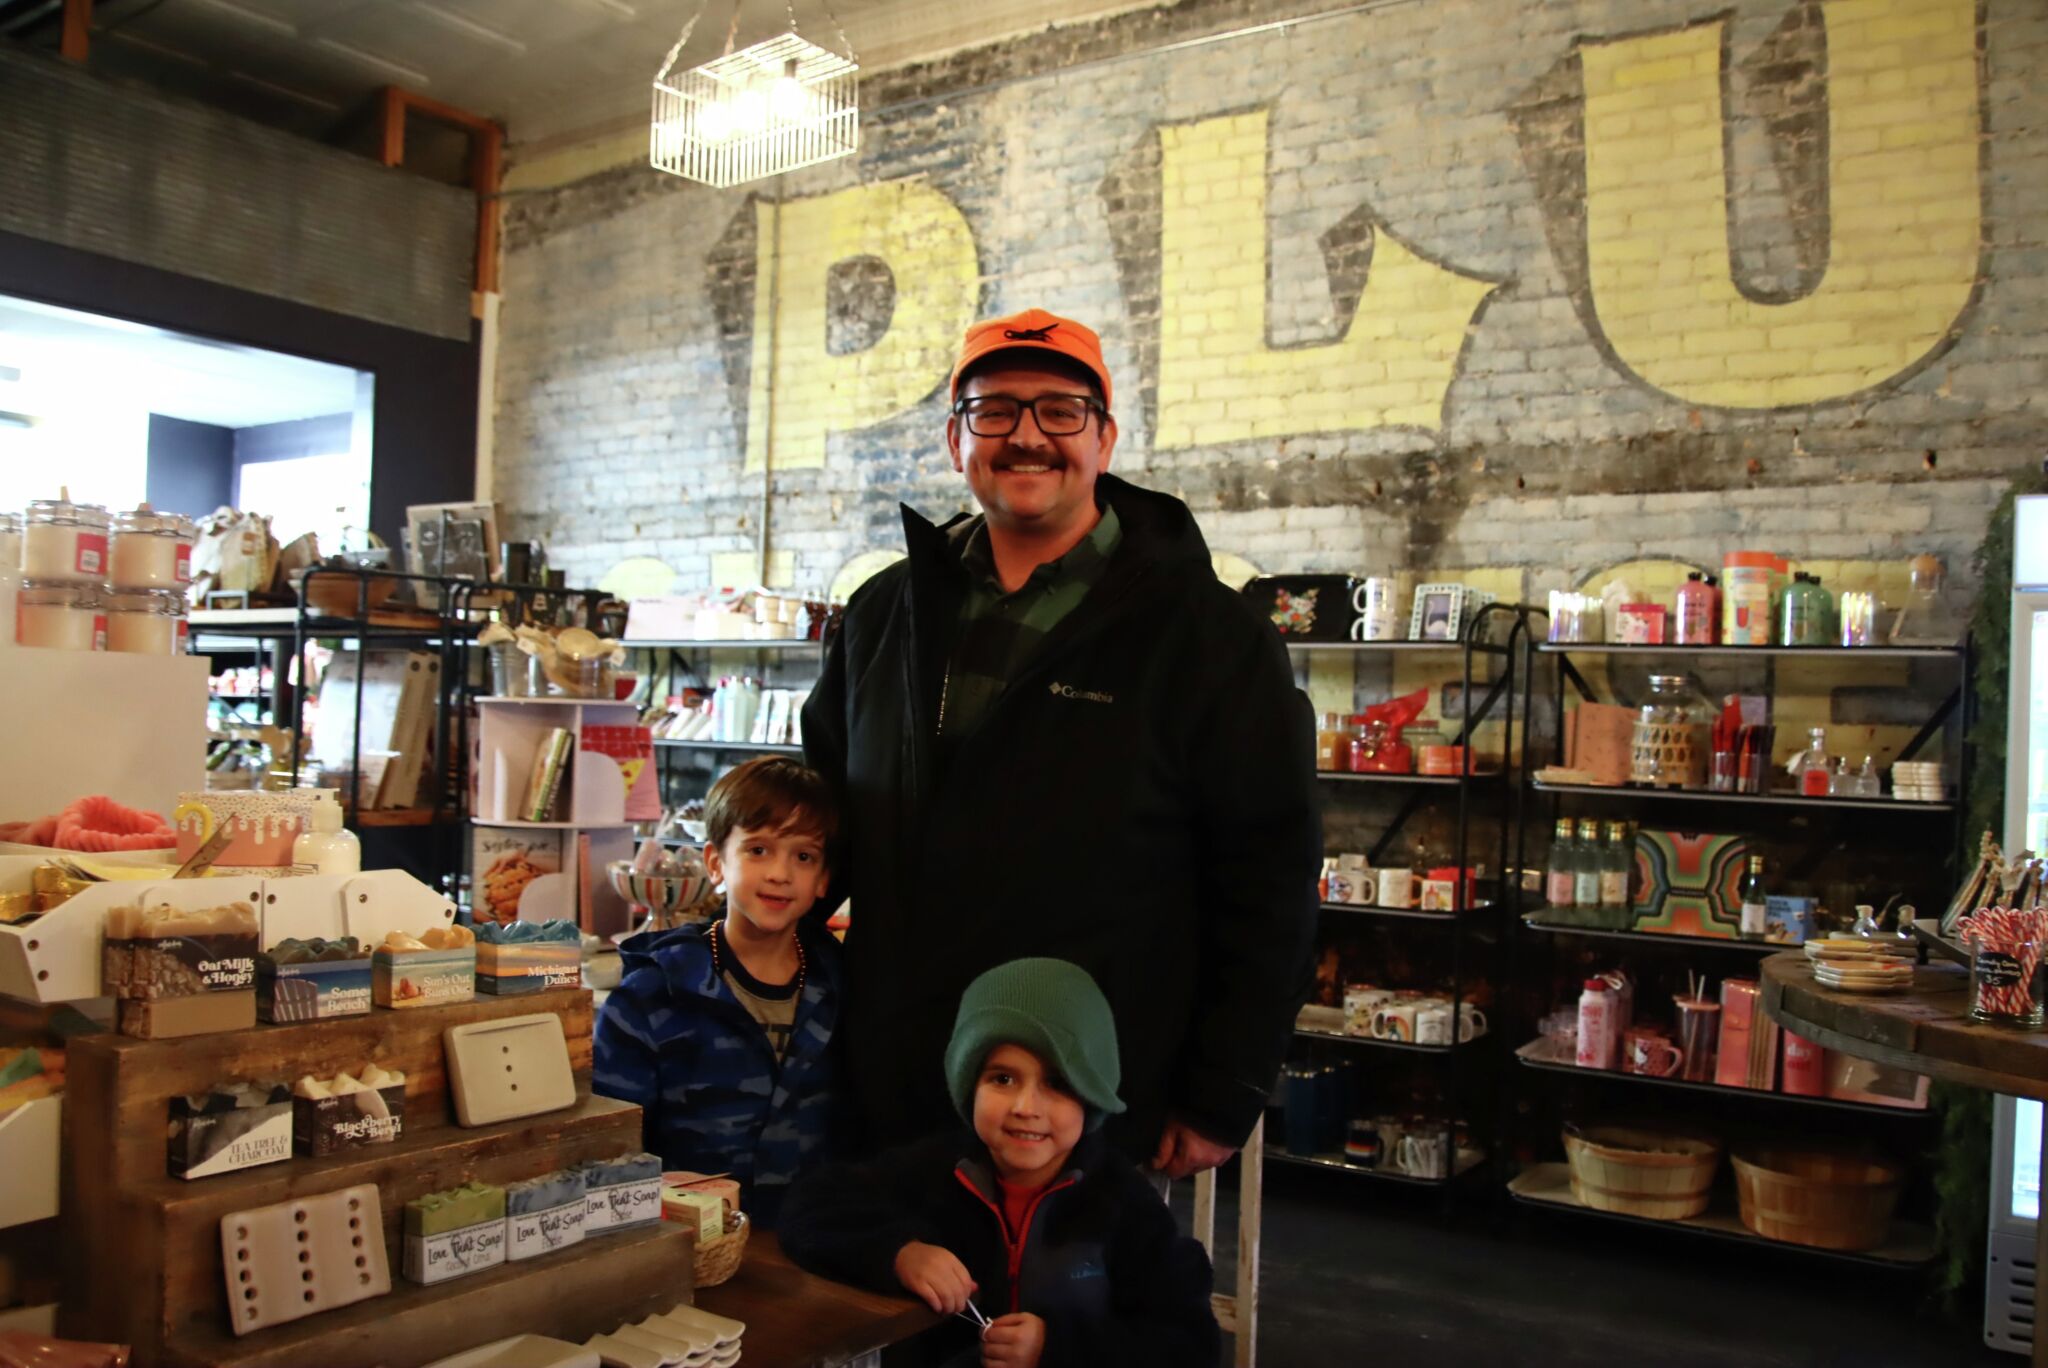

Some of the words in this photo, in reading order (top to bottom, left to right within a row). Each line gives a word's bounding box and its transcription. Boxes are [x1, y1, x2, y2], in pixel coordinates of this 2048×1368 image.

[198, 960, 222, 972] Oat
[222, 957, 255, 973] Milk
[527, 964, 578, 977] Michigan
[202, 975, 212, 984] &
[212, 971, 253, 986] Honey
[544, 975, 578, 986] Dunes
[331, 986, 368, 999] Some
[327, 998, 367, 1013] Beach
[333, 1113, 402, 1139] Blackberry
[587, 1199, 606, 1215] Love
[633, 1186, 660, 1206] Soap!
[517, 1226, 537, 1242] Love
[428, 1248, 448, 1265] Love
